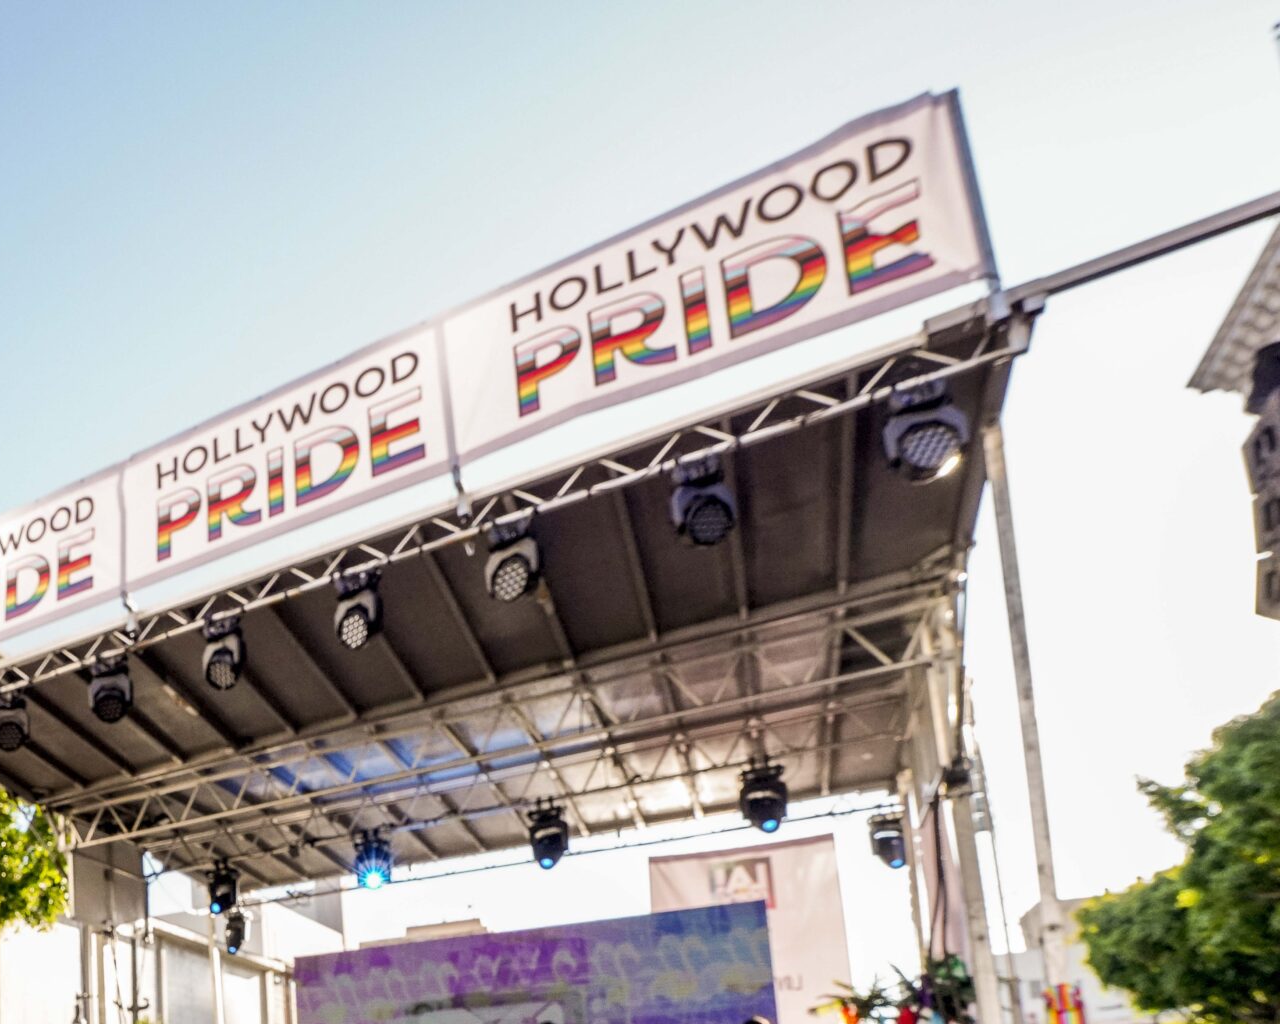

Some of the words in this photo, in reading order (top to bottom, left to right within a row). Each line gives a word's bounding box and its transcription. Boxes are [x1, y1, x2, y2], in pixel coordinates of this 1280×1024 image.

[510, 138, 912, 332] HOLLYWOOD
[513, 178, 935, 418] PRIDE
[156, 351, 418, 489] HOLLYWOOD
[156, 386, 426, 562] PRIDE
